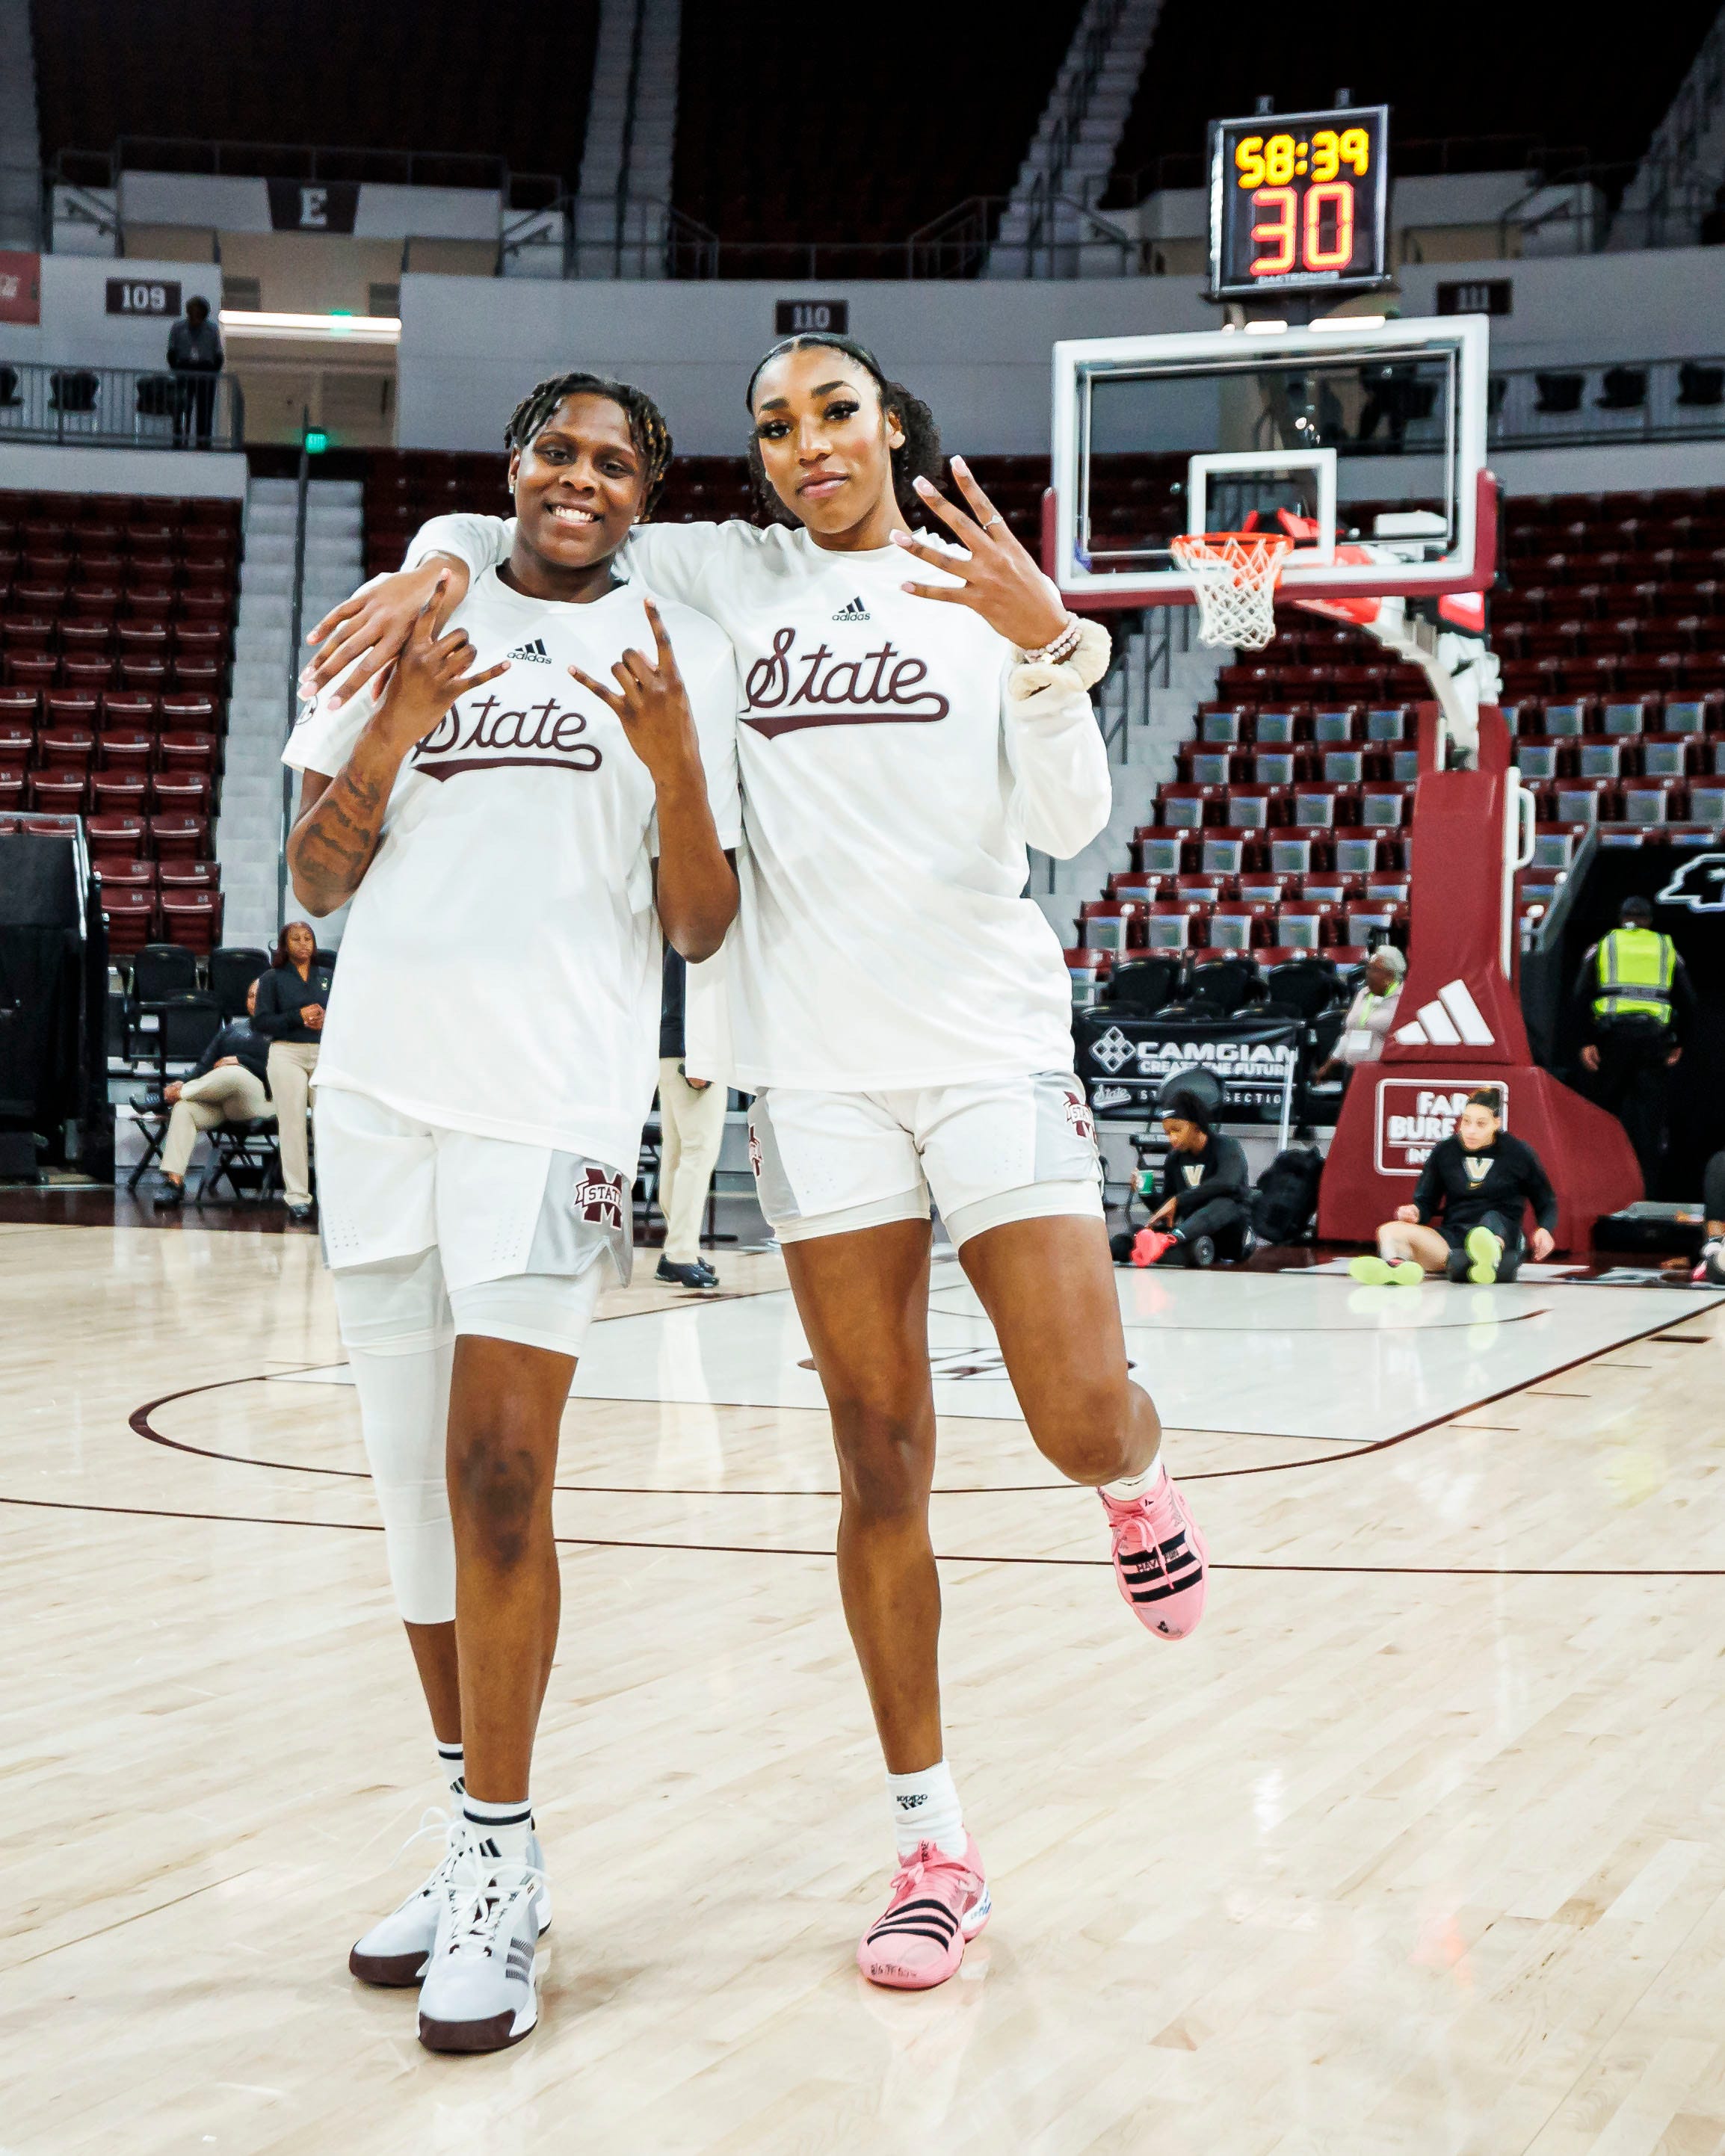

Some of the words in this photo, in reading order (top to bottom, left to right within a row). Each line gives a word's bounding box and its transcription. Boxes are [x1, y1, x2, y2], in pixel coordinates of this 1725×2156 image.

[1235, 128, 1369, 188] 58:39
[300, 188, 327, 226] E
[1250, 182, 1354, 276] 30
[122, 285, 166, 311] 109
[1458, 285, 1490, 311] 111
[794, 306, 830, 329] 110
[832, 612, 871, 621] adidas
[507, 651, 552, 664] adidas
[737, 627, 949, 740] State
[1138, 1042, 1299, 1063] CAMGIAN
[1233, 1063, 1286, 1076] FUTUR
[1223, 1092, 1282, 1104] SECTIO
[1417, 1091, 1469, 1116] FAR
[1388, 1116, 1457, 1141] BURE
[1182, 1164, 1205, 1188] V
[1463, 1157, 1494, 1181] V
